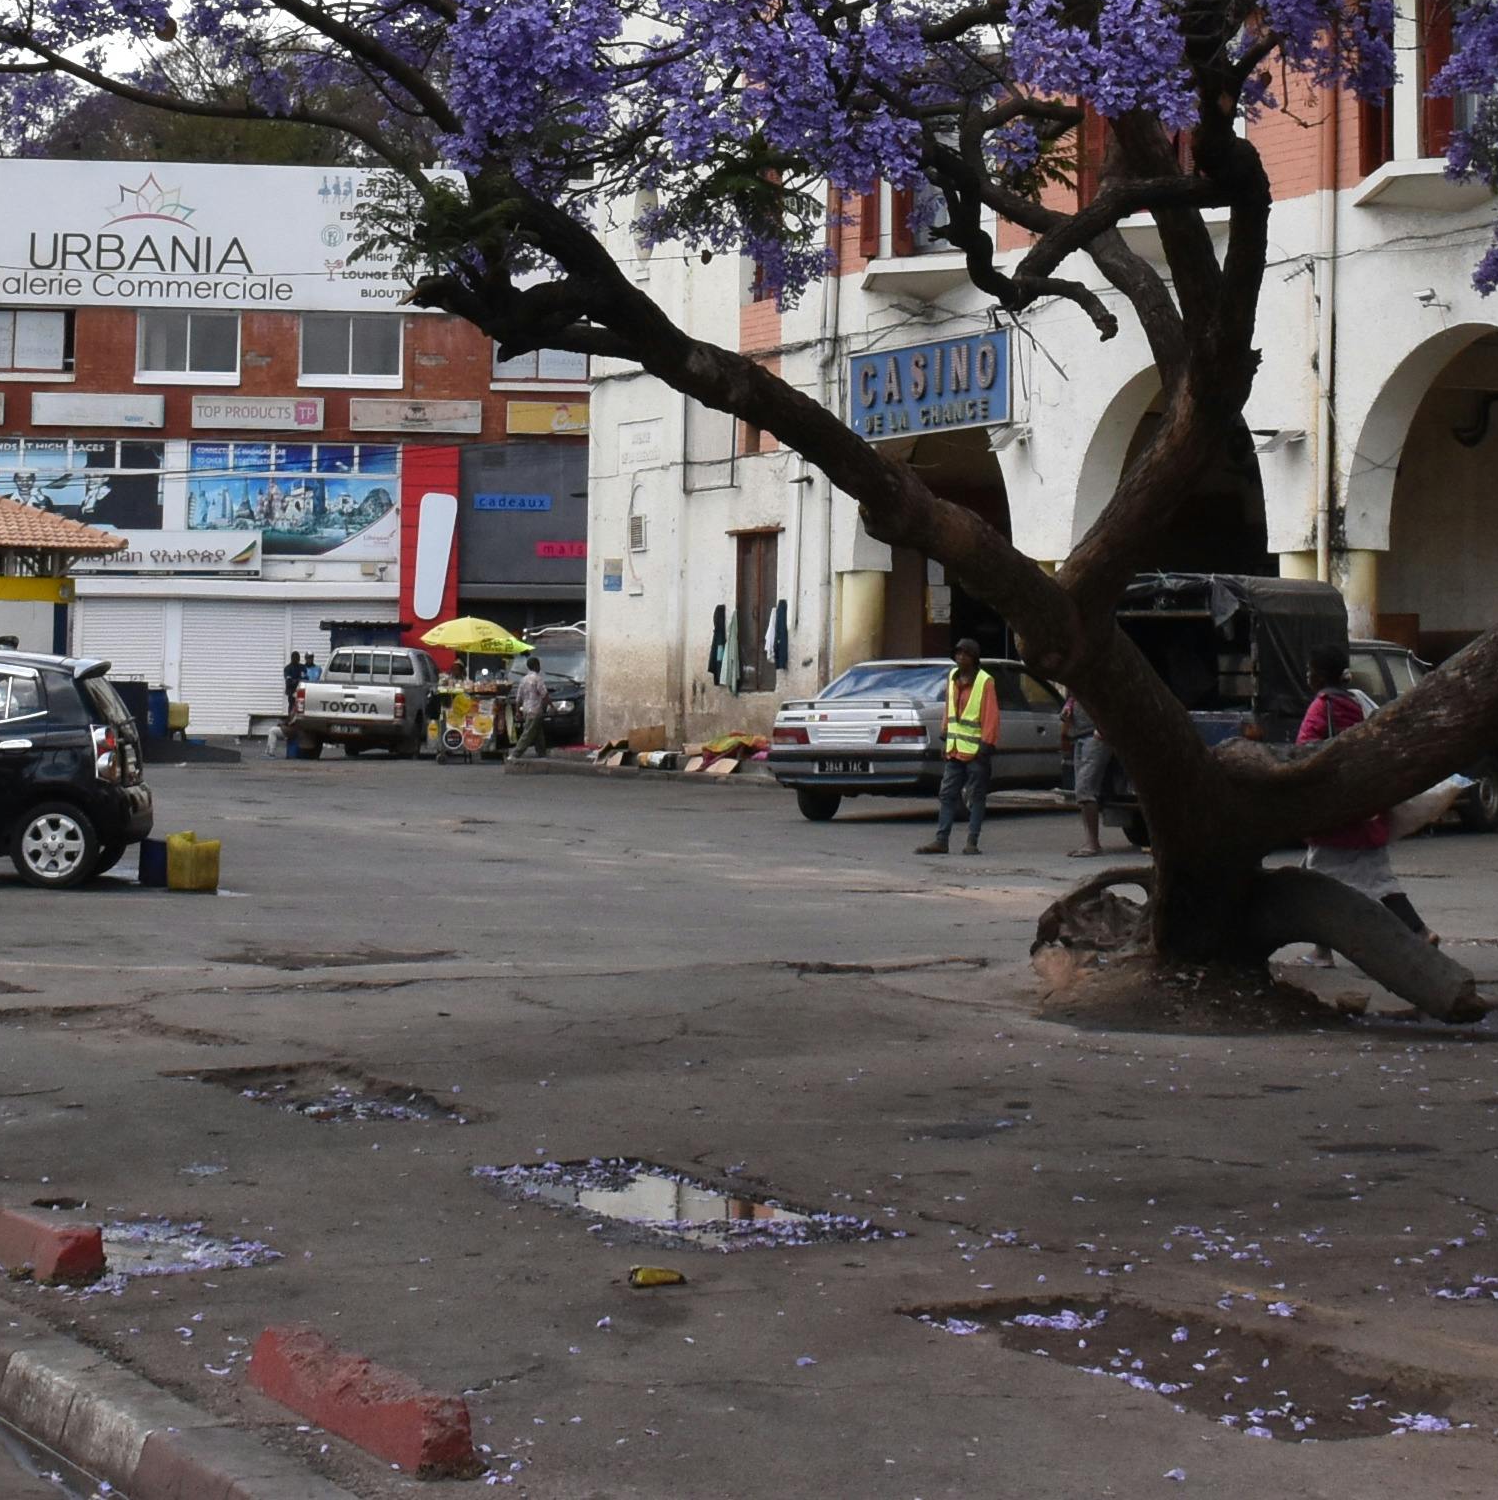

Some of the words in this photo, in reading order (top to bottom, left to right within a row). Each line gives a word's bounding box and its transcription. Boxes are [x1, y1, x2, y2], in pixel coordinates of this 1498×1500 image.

[30, 233, 253, 274] URBANIA
[365, 254, 393, 262] HIGH
[342, 271, 389, 280] LOUNGE
[92, 273, 294, 301] Commerciale
[859, 339, 997, 408] CASINO
[197, 405, 221, 419] TOP
[225, 405, 292, 420] PRODUCTS
[300, 406, 316, 420] TP
[864, 412, 884, 435] DE
[920, 396, 990, 426] CHANCE
[37, 443, 64, 452] HIGH
[72, 443, 105, 453] LACES
[478, 496, 546, 508] cadeaux
[320, 700, 378, 715] TOYOTA
